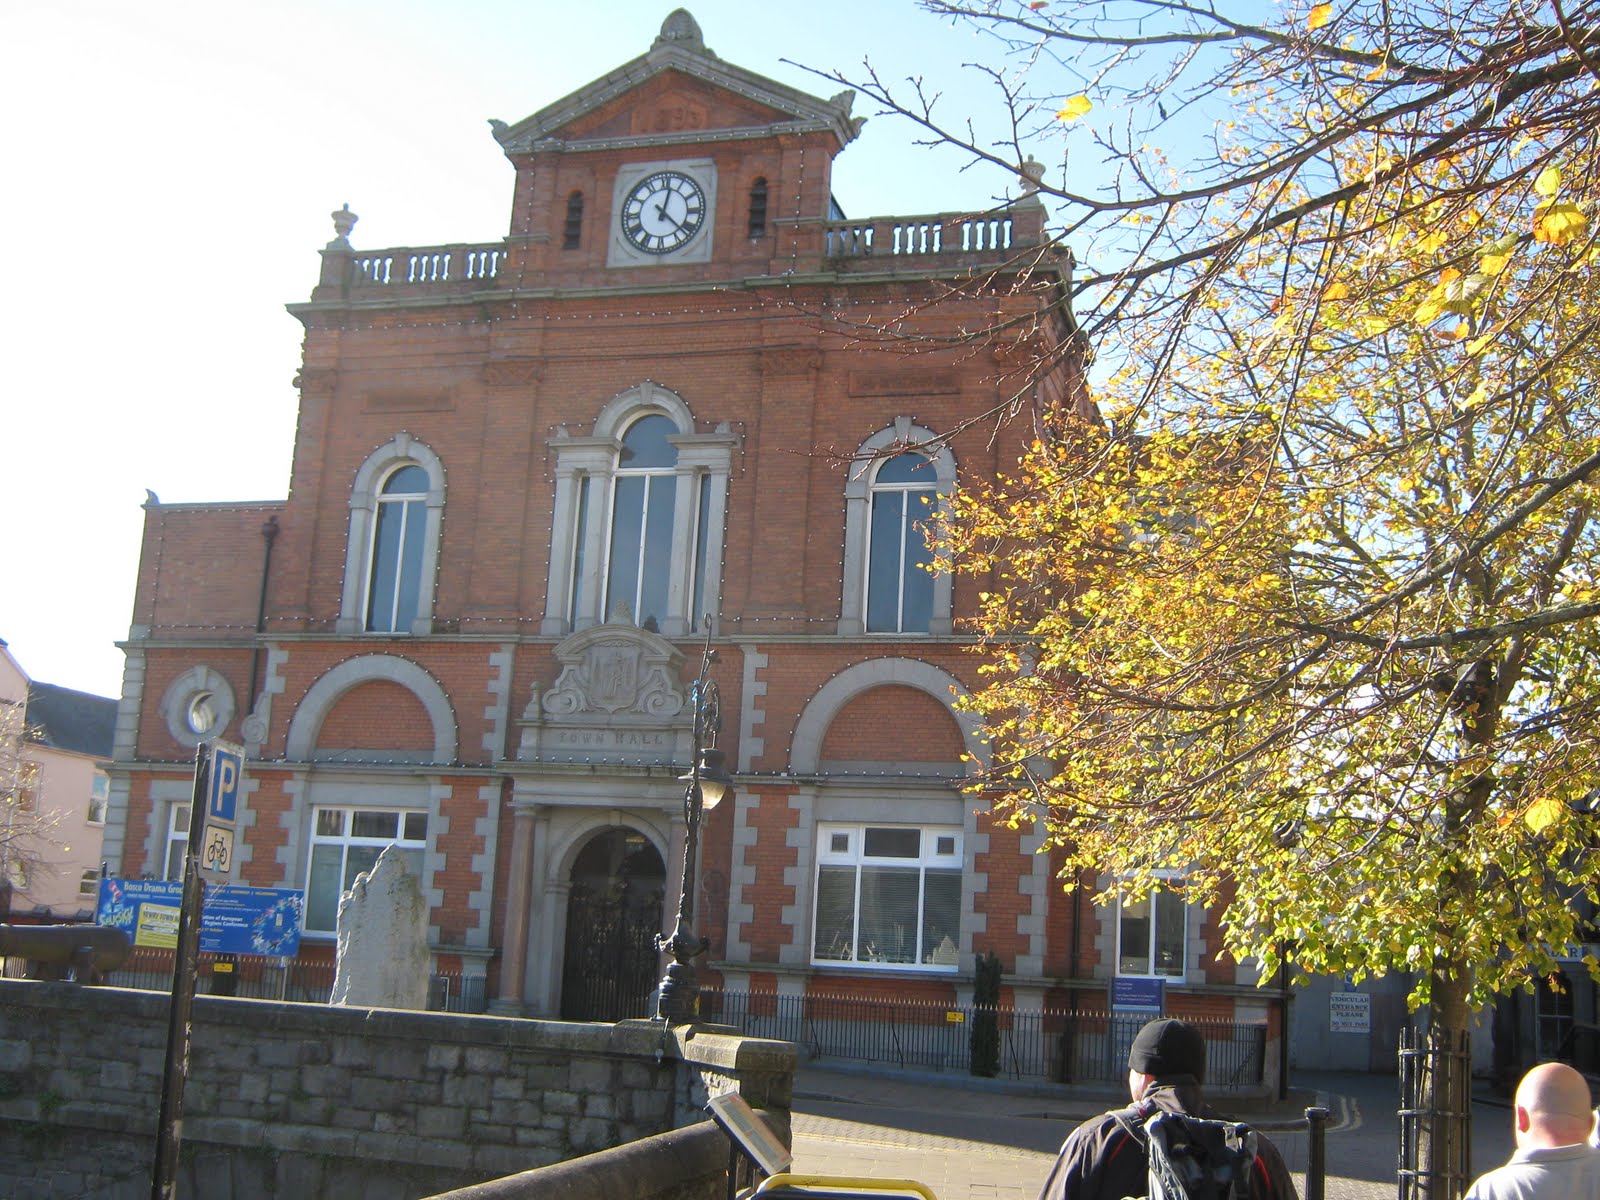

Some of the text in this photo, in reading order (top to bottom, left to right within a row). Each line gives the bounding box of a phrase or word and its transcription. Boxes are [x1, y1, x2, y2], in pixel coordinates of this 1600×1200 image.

[559, 732, 663, 745] TOWN HALL
[216, 758, 236, 812] P
[124, 881, 142, 891] Bosco
[144, 882, 166, 892] Drama
